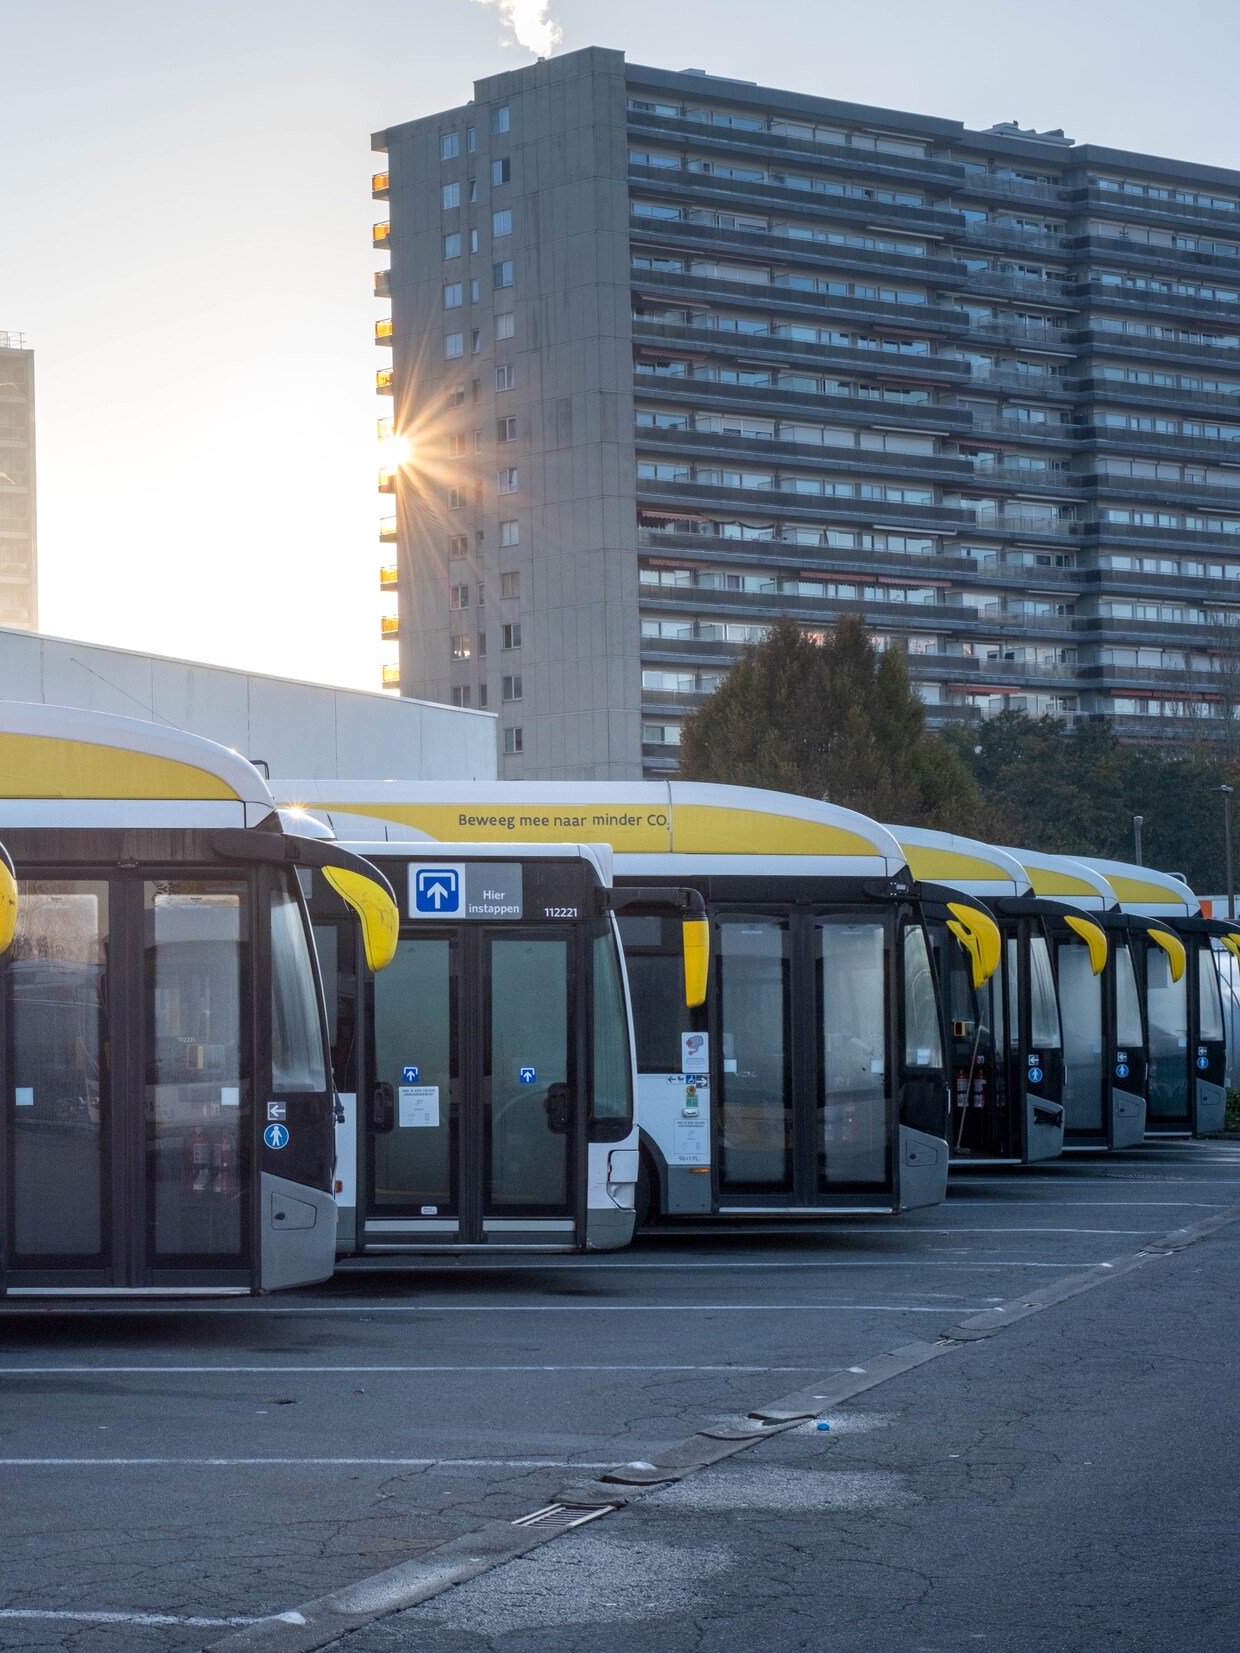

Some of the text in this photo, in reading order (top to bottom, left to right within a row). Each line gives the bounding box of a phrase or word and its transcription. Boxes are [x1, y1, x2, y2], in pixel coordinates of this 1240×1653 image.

[459, 814, 515, 829] Beweeg
[520, 816, 549, 826] mee
[554, 816, 587, 827] naar
[592, 813, 642, 826] minder
[483, 890, 505, 900] Hier
[469, 904, 520, 915] instappen
[544, 907, 578, 918] 112221
